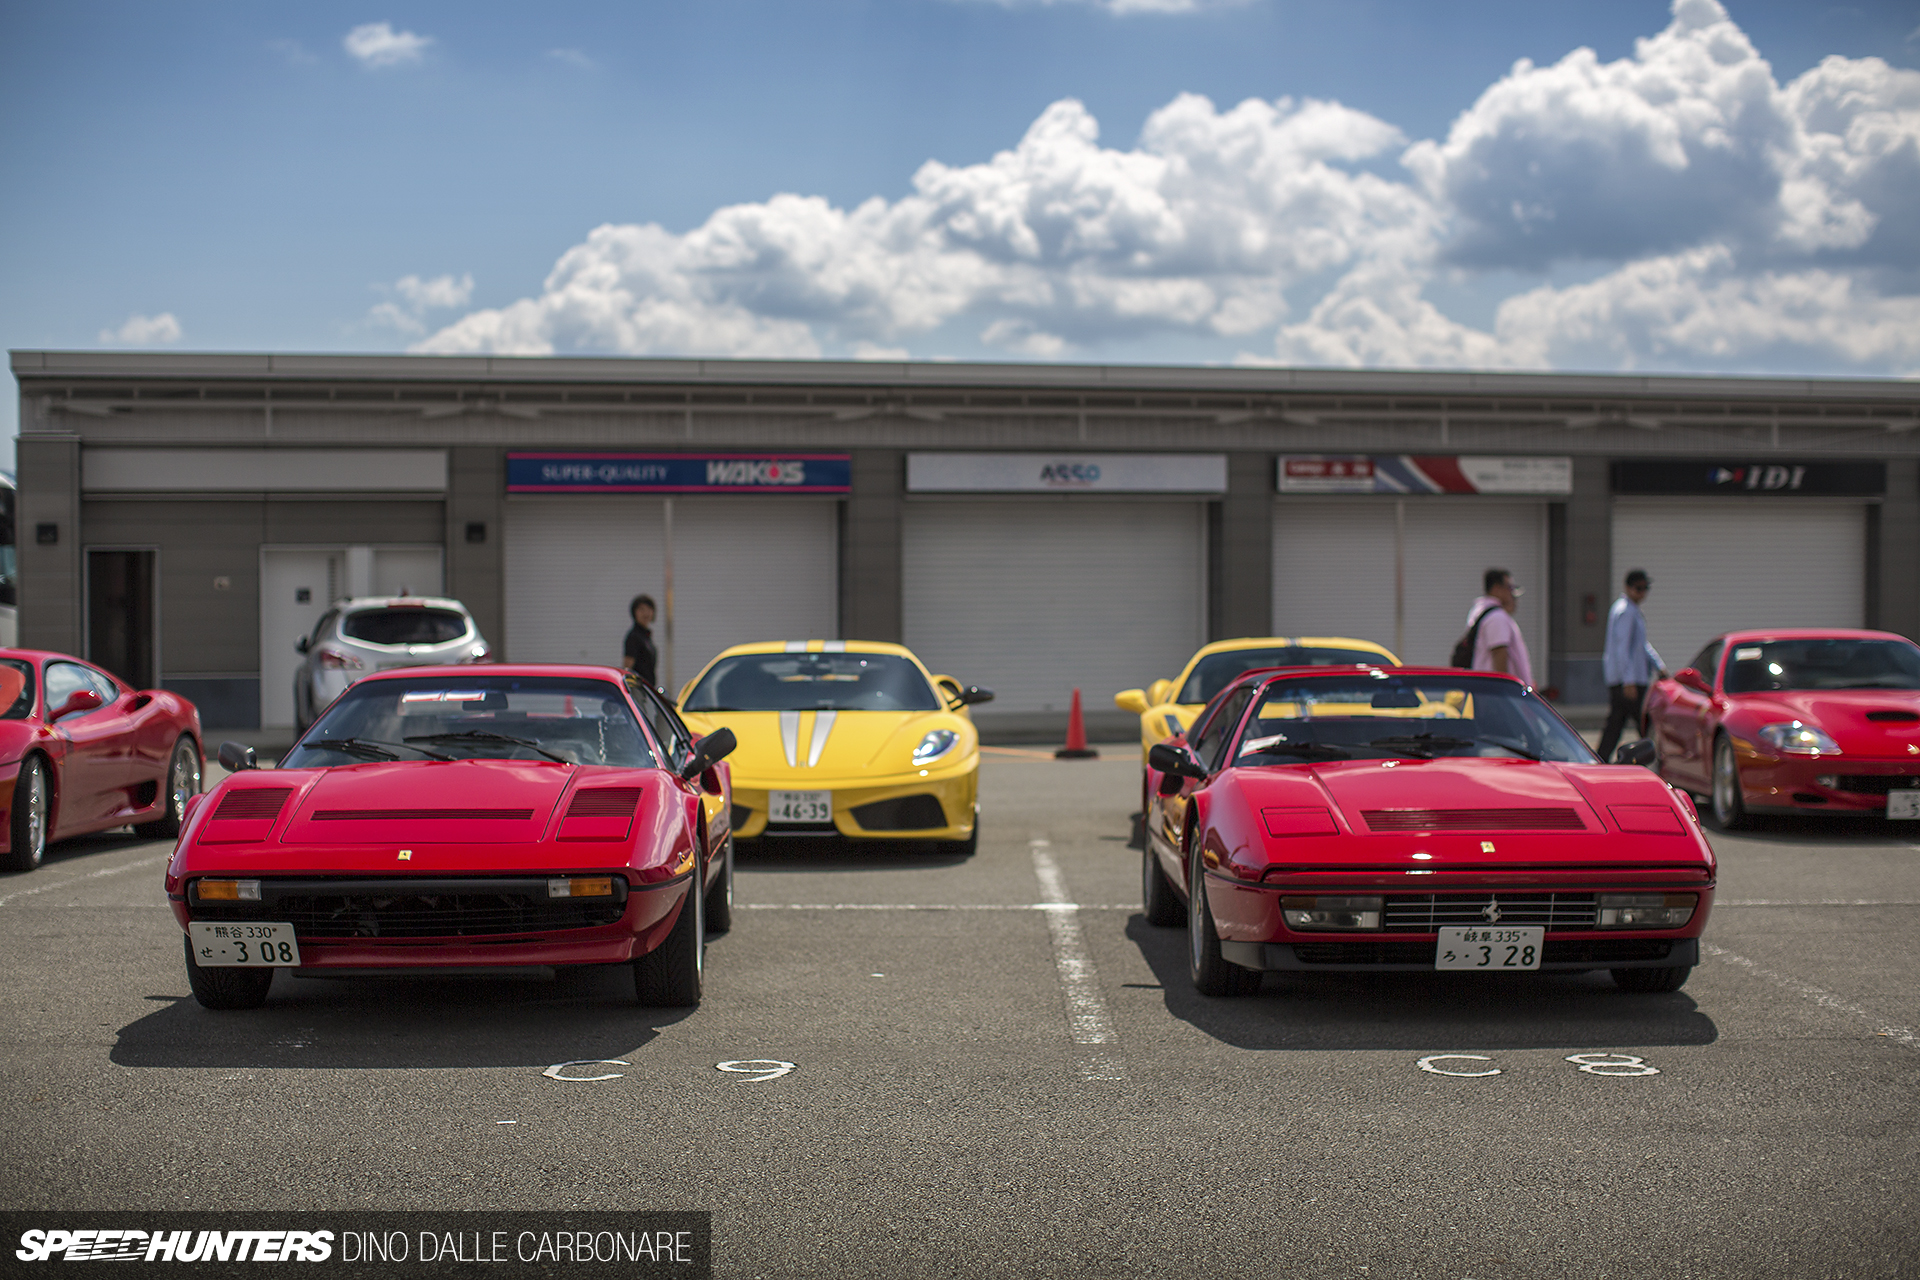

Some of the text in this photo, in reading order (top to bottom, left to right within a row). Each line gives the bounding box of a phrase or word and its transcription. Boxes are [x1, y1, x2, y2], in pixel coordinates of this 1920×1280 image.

[541, 464, 668, 483] SUPER-QUALITY
[1746, 465, 1805, 489] IDI
[214, 926, 272, 938] 熊谷 330
[1464, 930, 1520, 943] 岐阜 335
[200, 946, 213, 958] せ
